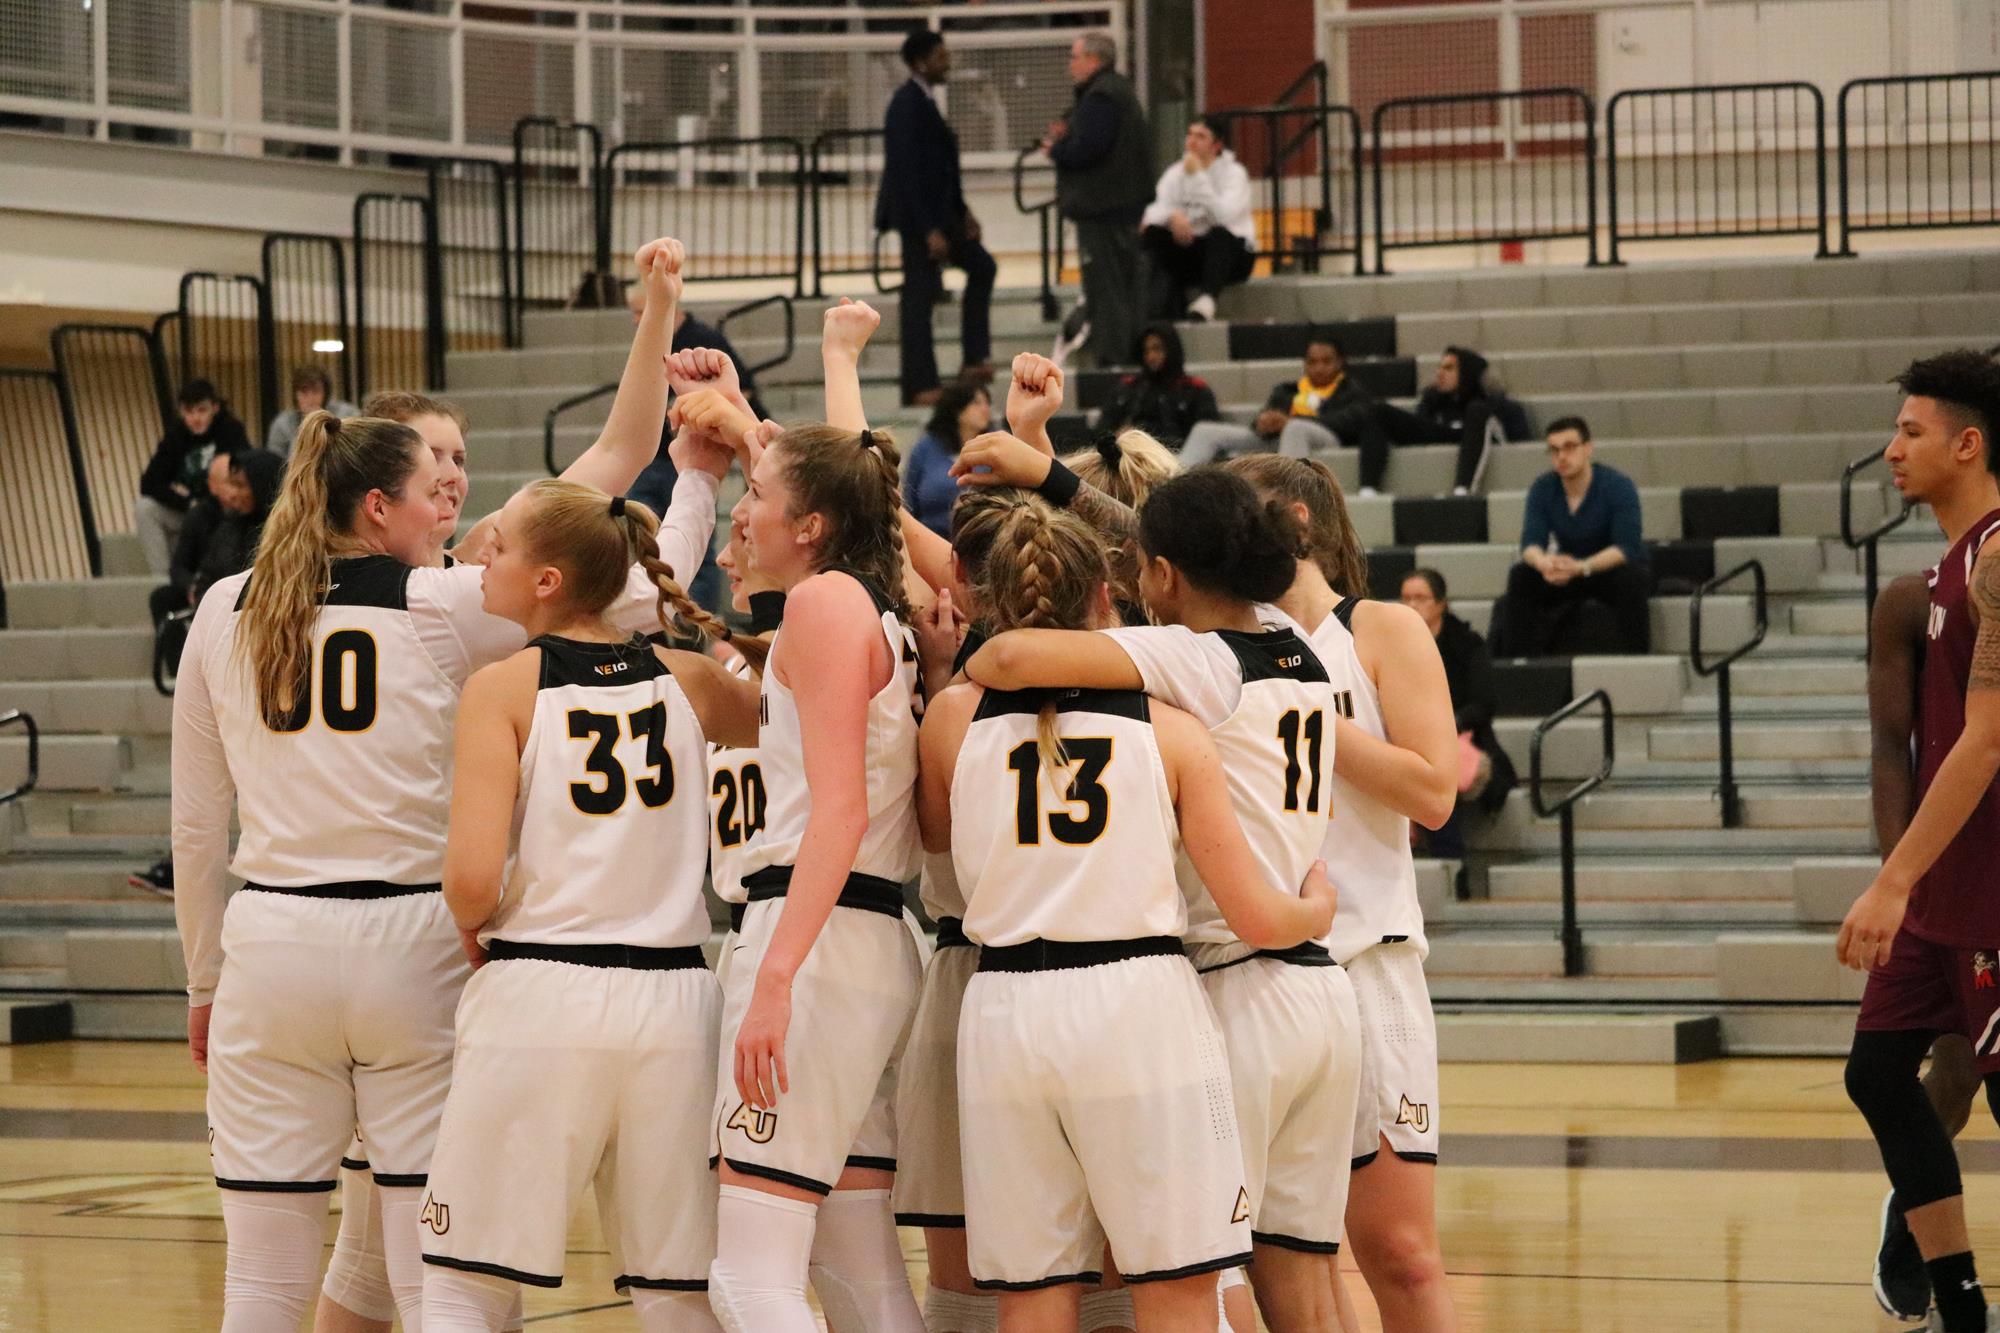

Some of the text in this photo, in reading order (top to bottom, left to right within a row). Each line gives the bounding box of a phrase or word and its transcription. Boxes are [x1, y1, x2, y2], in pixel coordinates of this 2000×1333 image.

[565, 698, 676, 817] 33
[1007, 735, 1115, 847] 13
[1276, 706, 1323, 816] 11
[711, 760, 767, 850] 20
[726, 1101, 777, 1144] AU
[1395, 1093, 1430, 1133] AU
[421, 1190, 450, 1236] AU
[1230, 1185, 1249, 1224] A
